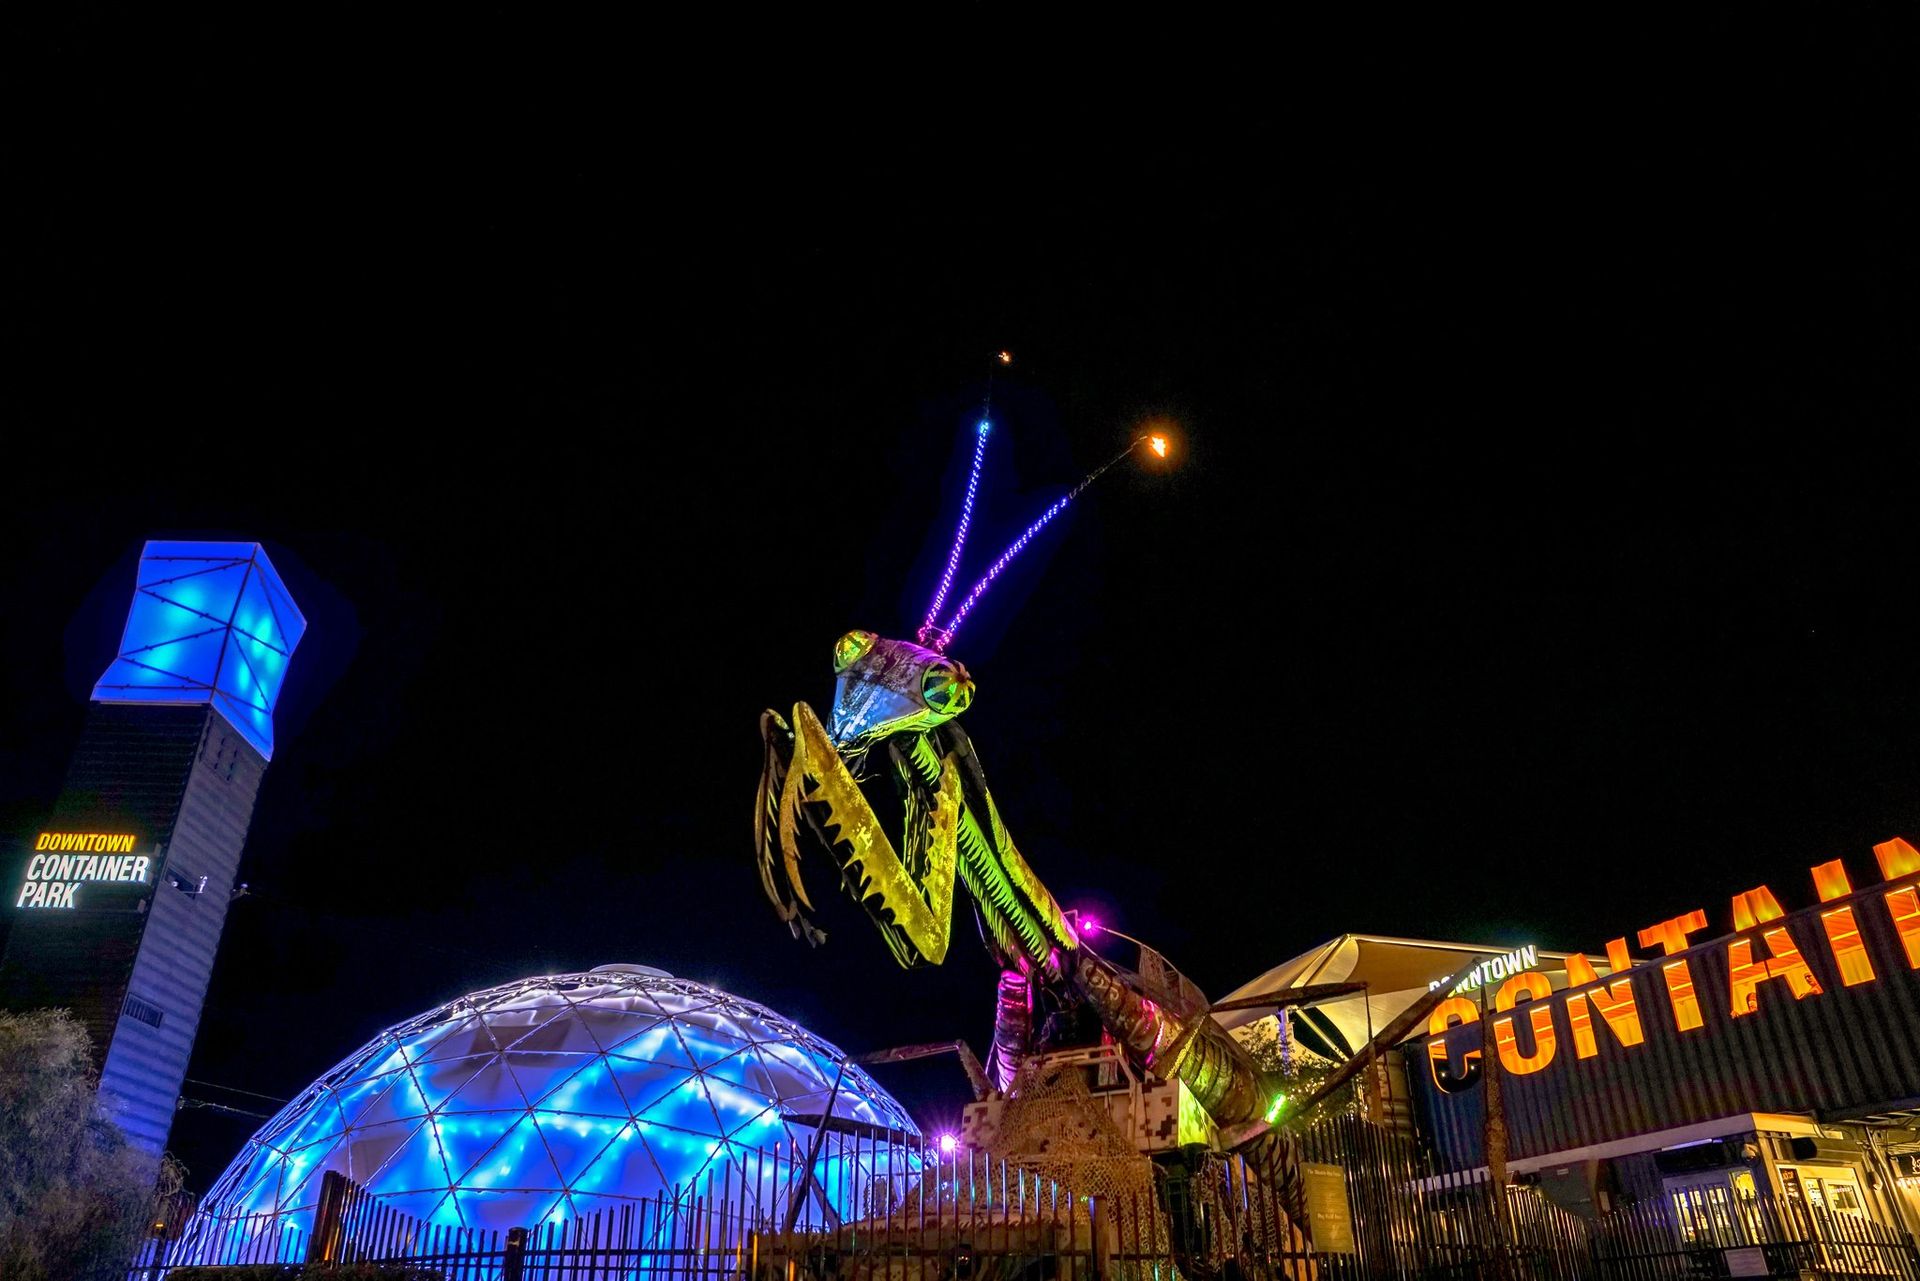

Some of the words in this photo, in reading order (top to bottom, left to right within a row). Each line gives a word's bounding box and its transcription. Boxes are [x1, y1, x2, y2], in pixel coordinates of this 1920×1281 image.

[36, 833, 136, 852] DOWNTOWN
[27, 854, 149, 882] CONTAINER
[16, 882, 81, 909] PARK
[1428, 944, 1539, 997] DWNTOWN
